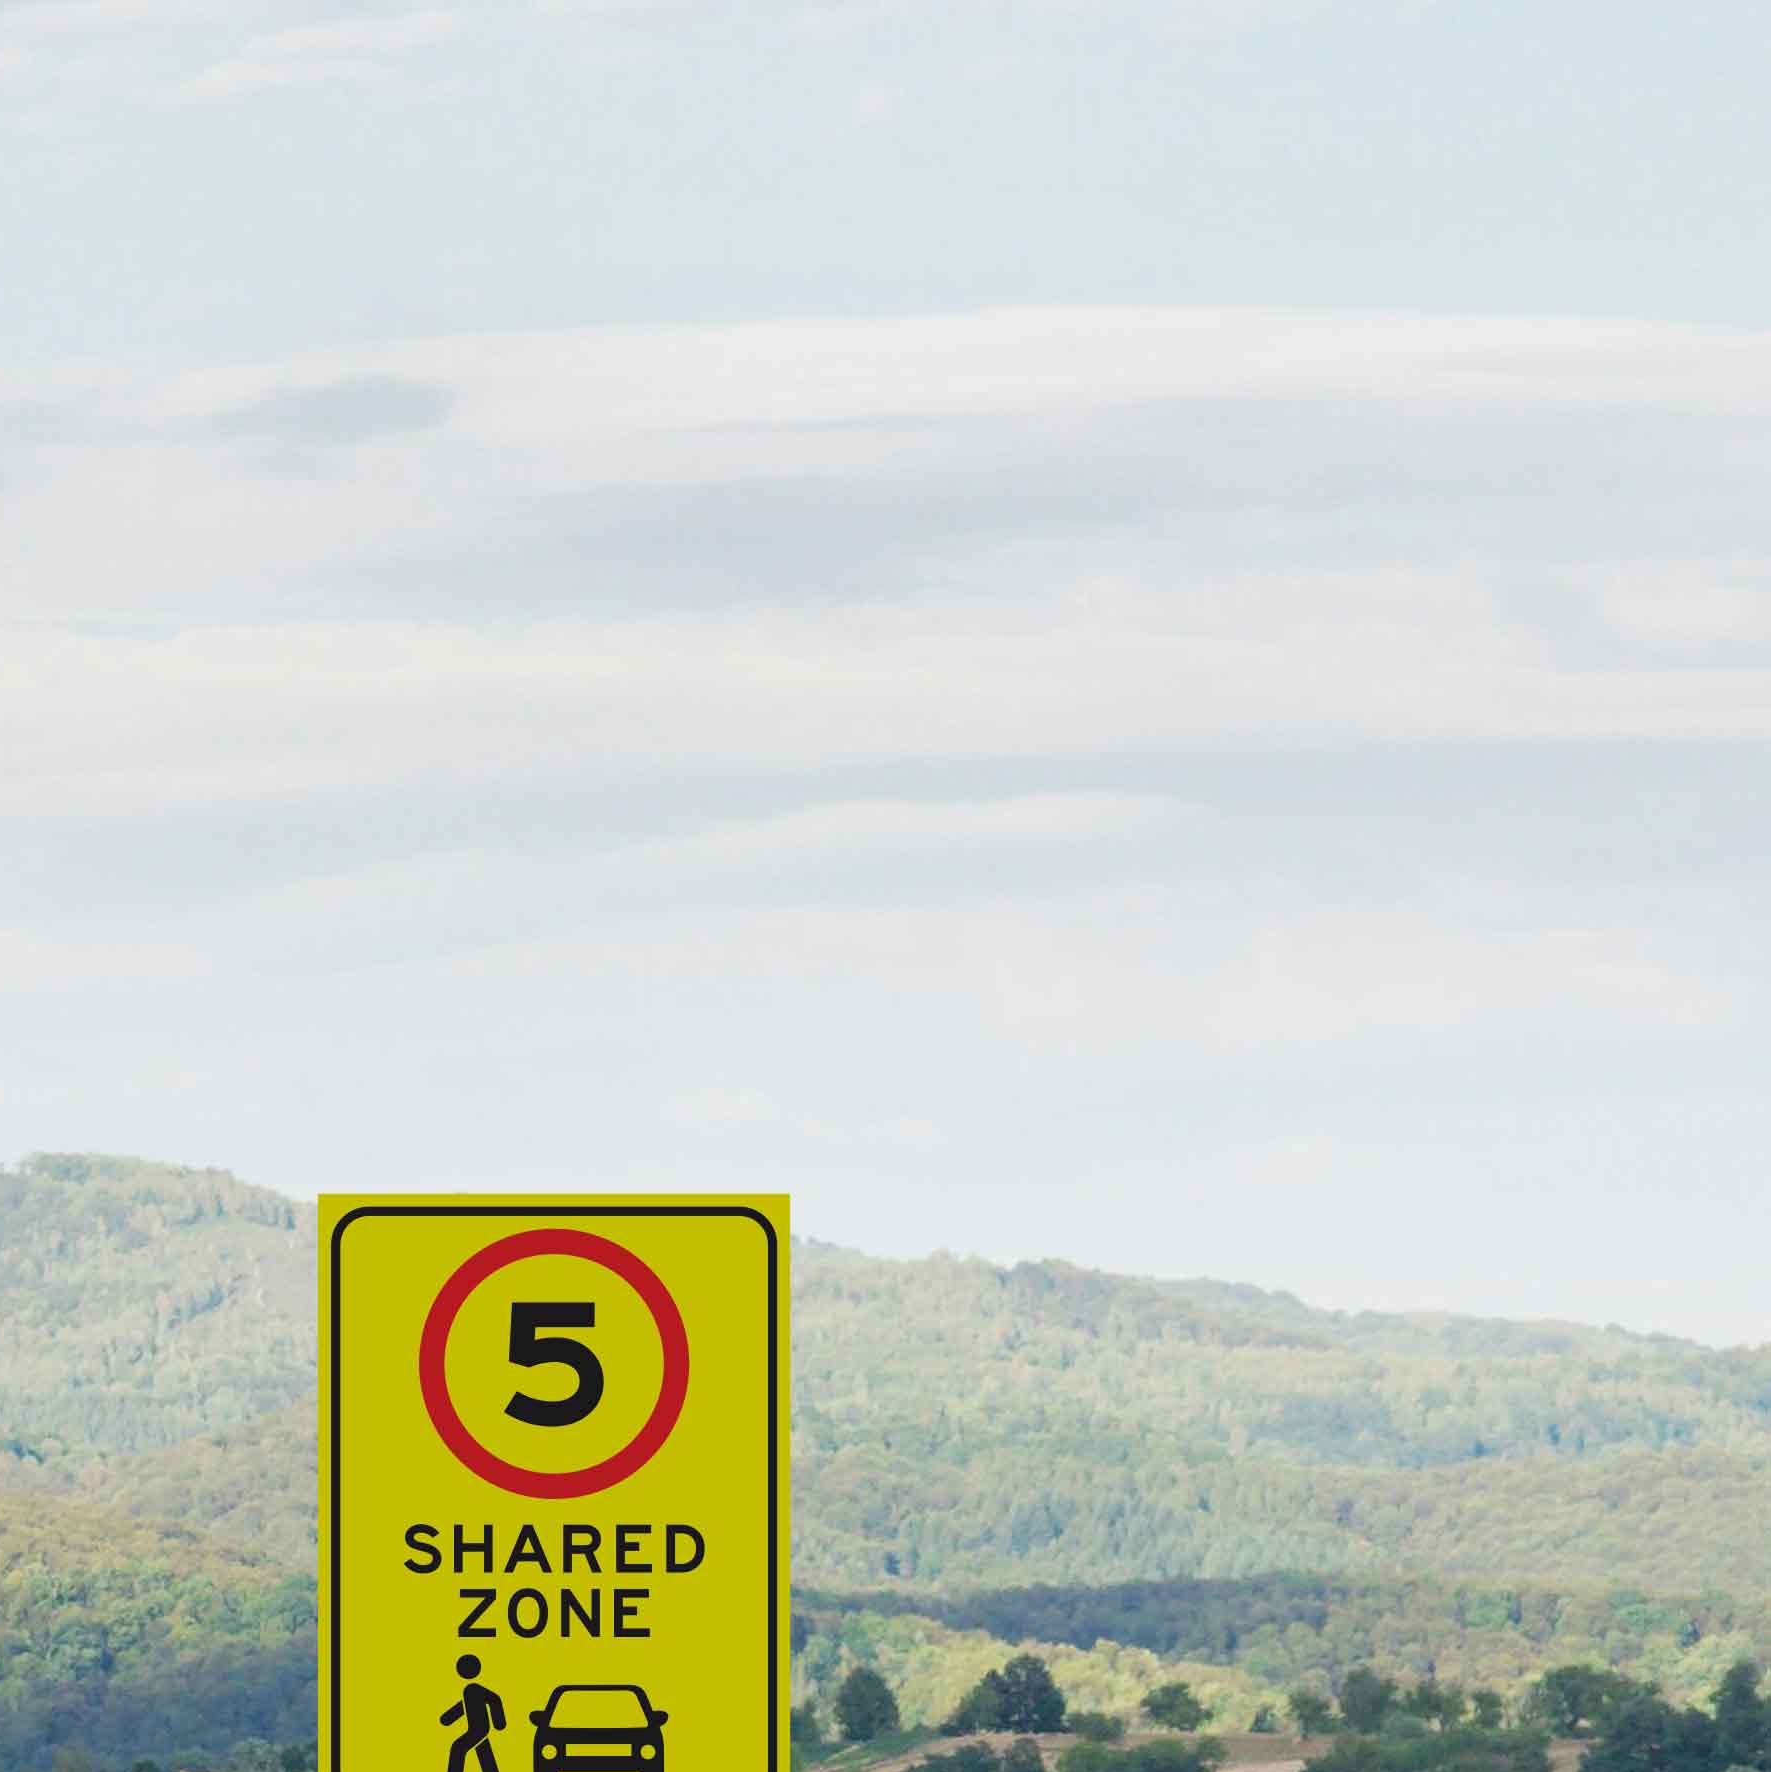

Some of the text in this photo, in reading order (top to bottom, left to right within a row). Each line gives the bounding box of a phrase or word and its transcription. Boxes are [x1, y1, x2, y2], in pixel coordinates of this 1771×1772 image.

[504, 1302, 604, 1427] 5
[404, 1524, 705, 1574] SHARED
[458, 1588, 651, 1638] ZONE
